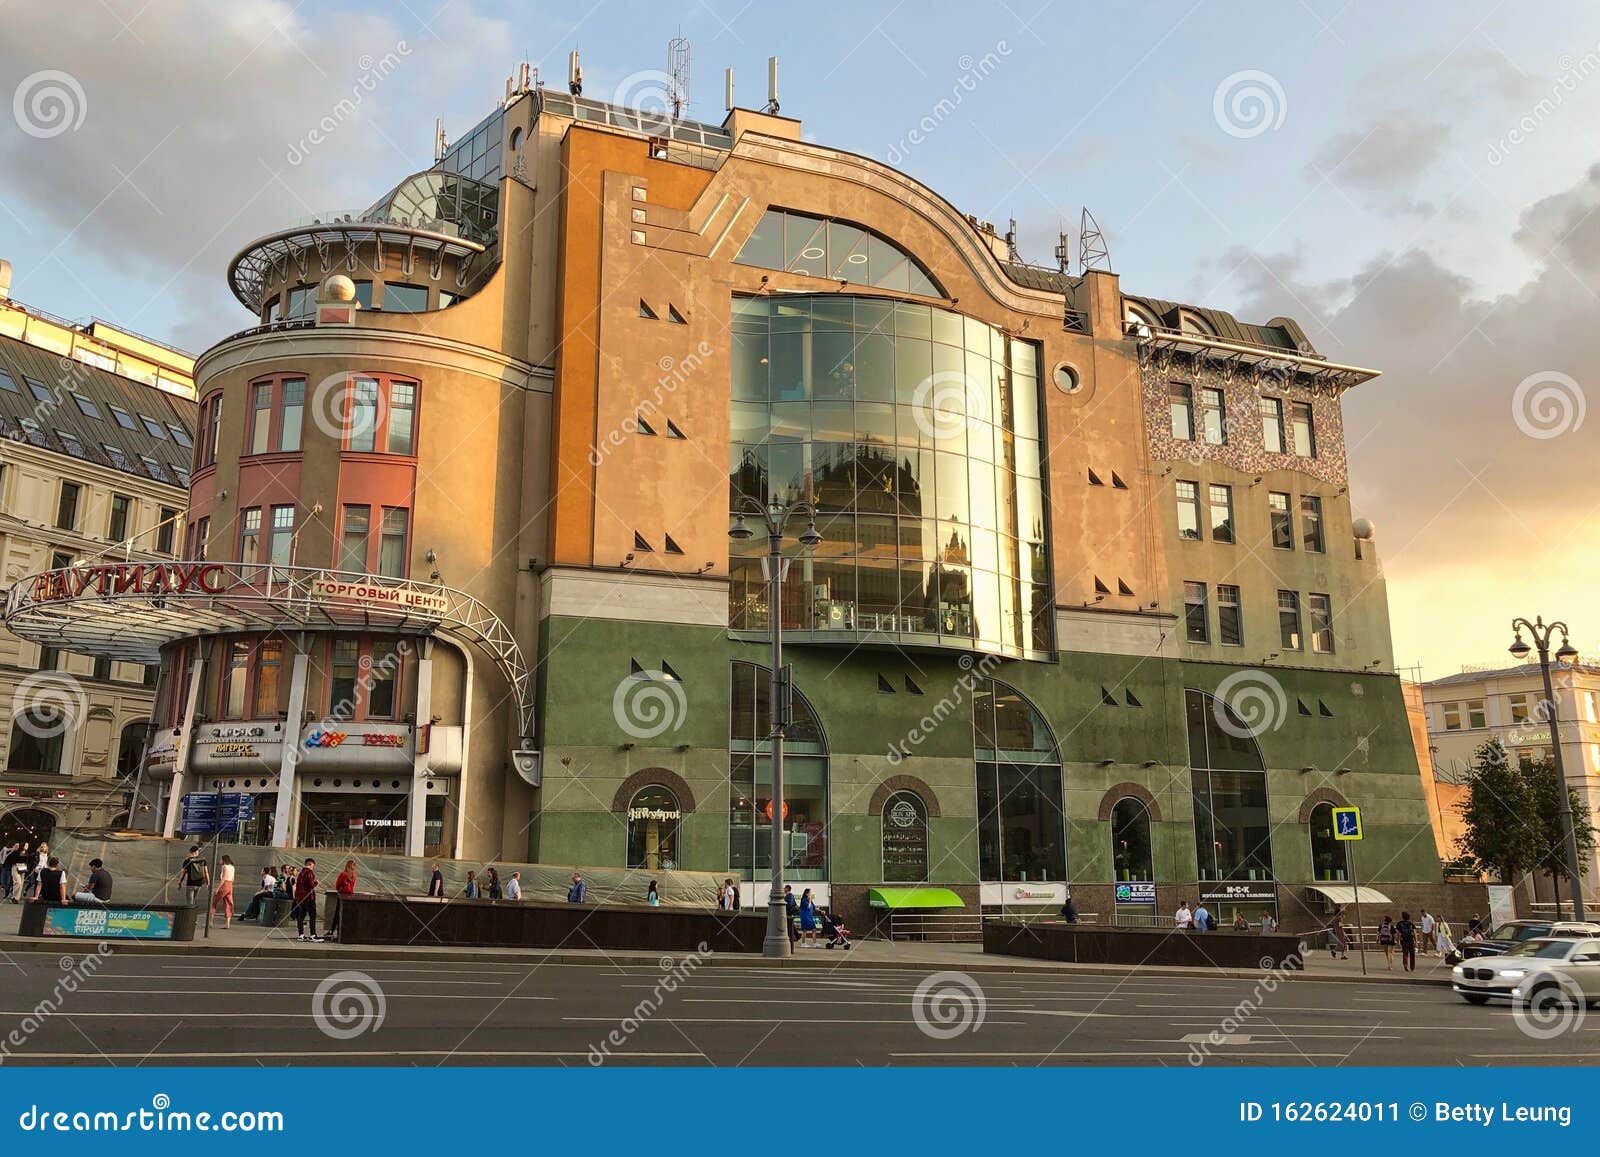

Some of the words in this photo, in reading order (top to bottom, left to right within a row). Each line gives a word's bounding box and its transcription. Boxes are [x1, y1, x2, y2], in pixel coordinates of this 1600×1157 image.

[33, 564, 226, 602] НАУТИЛУС
[316, 582, 400, 601] ТОРГОВЫЙ
[405, 593, 447, 609] ЦЕНТР
[392, 819, 407, 827] ЦВЕ
[1130, 884, 1155, 892] TEZ
